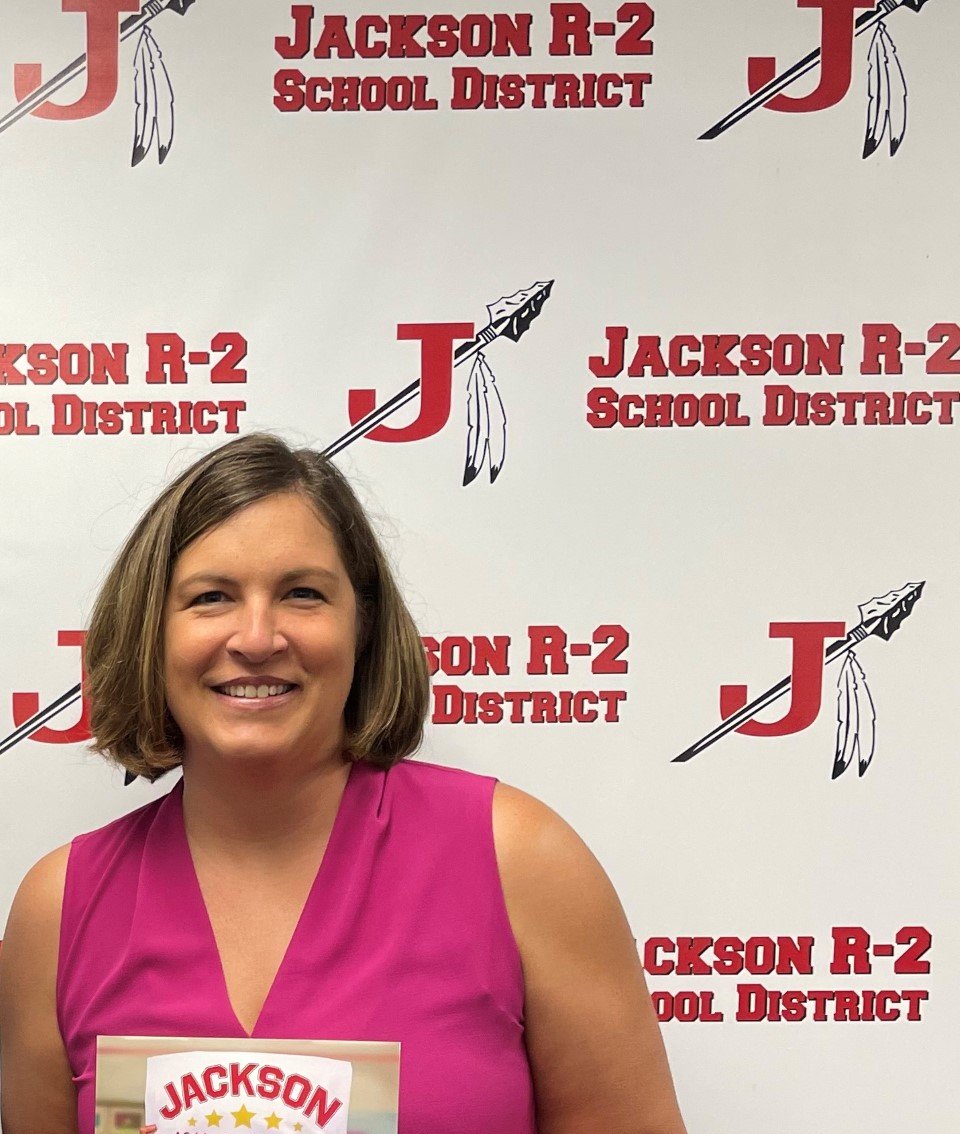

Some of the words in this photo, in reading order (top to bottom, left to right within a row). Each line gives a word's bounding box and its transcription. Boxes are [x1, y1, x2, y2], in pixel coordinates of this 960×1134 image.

[274, 4, 533, 59] JACKSON
[548, 1, 654, 56] R-2
[273, 68, 438, 112] SCHOOL
[450, 66, 652, 110] DISTRICT
[145, 332, 247, 384] R-2
[588, 326, 844, 378] JACKSON
[860, 322, 960, 375] R-2
[52, 394, 246, 435] DISTRICT
[586, 386, 750, 428] SCHOOL
[762, 384, 960, 426] DISTRICT
[526, 624, 629, 675] R-2
[431, 686, 628, 725] DISTRICT
[643, 937, 816, 976] CKSON
[829, 926, 932, 974] R-2
[735, 983, 929, 1022] DISTRICT
[159, 1063, 343, 1129] JACKSON
